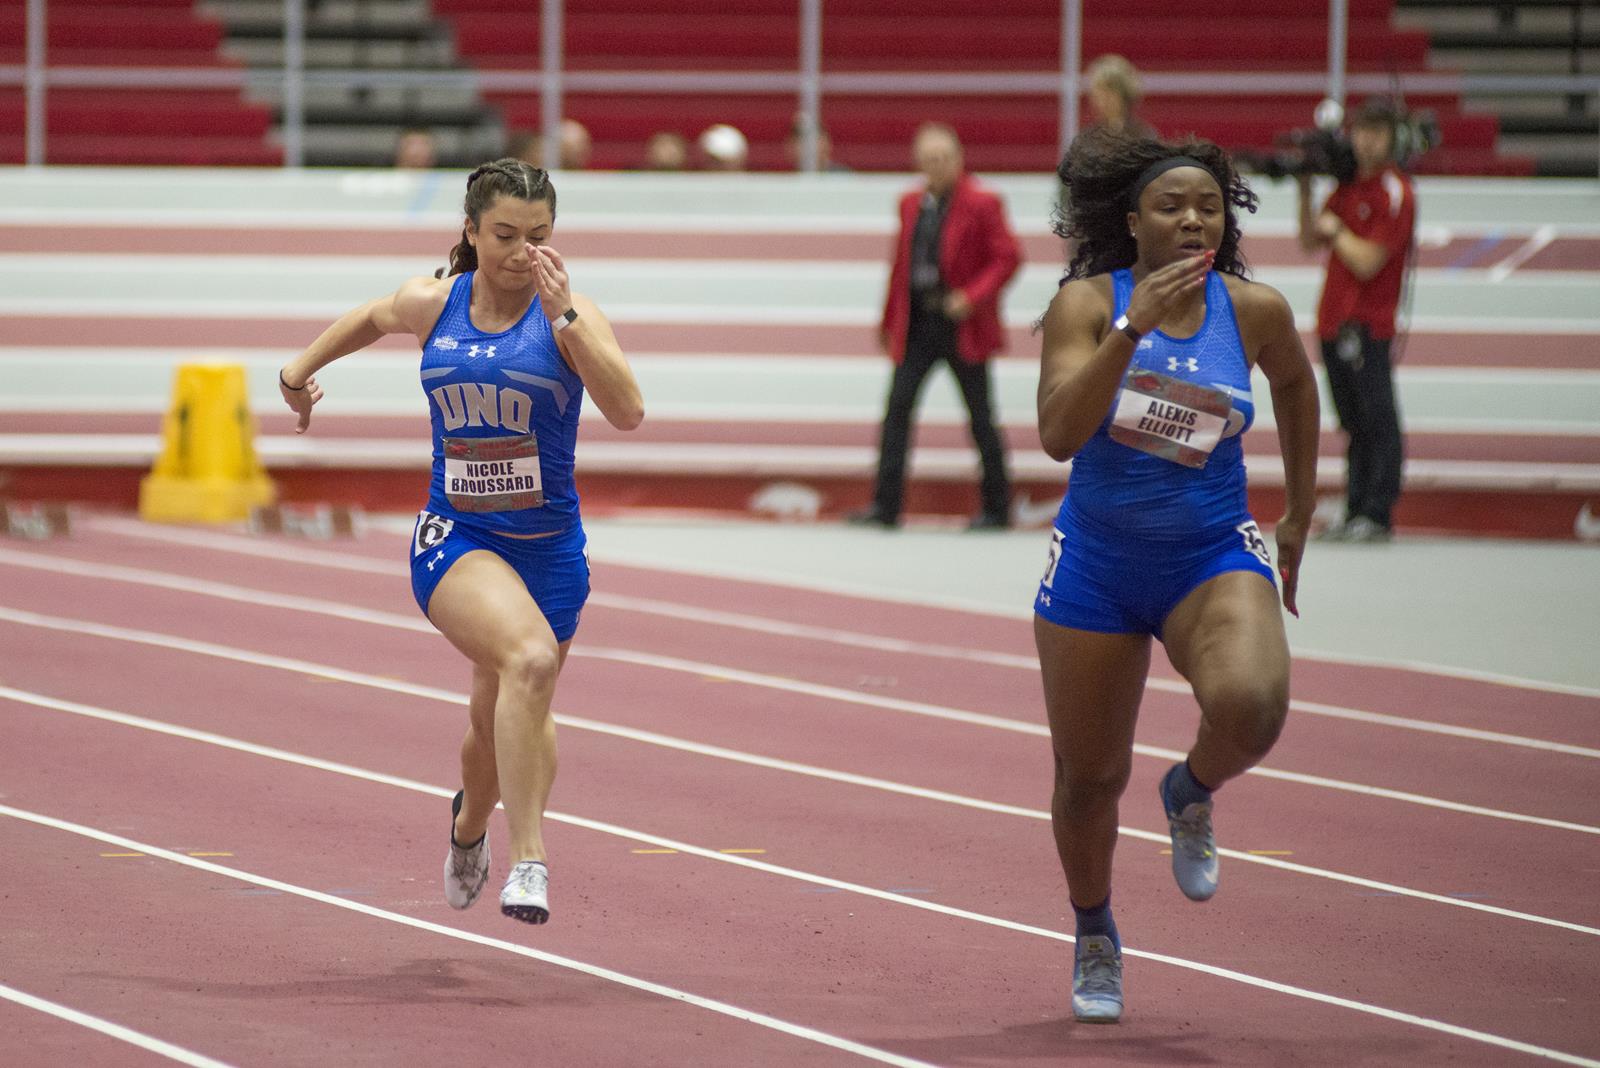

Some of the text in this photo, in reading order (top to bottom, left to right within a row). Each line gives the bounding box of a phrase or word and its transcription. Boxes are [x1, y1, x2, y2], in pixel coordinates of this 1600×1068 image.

[430, 383, 533, 433] UNO
[1146, 400, 1198, 427] ALEXIS
[1137, 417, 1196, 443] ELLIOTT
[466, 461, 514, 478] NICOLE
[451, 475, 535, 494] BROUSSARD
[418, 513, 448, 550] 6
